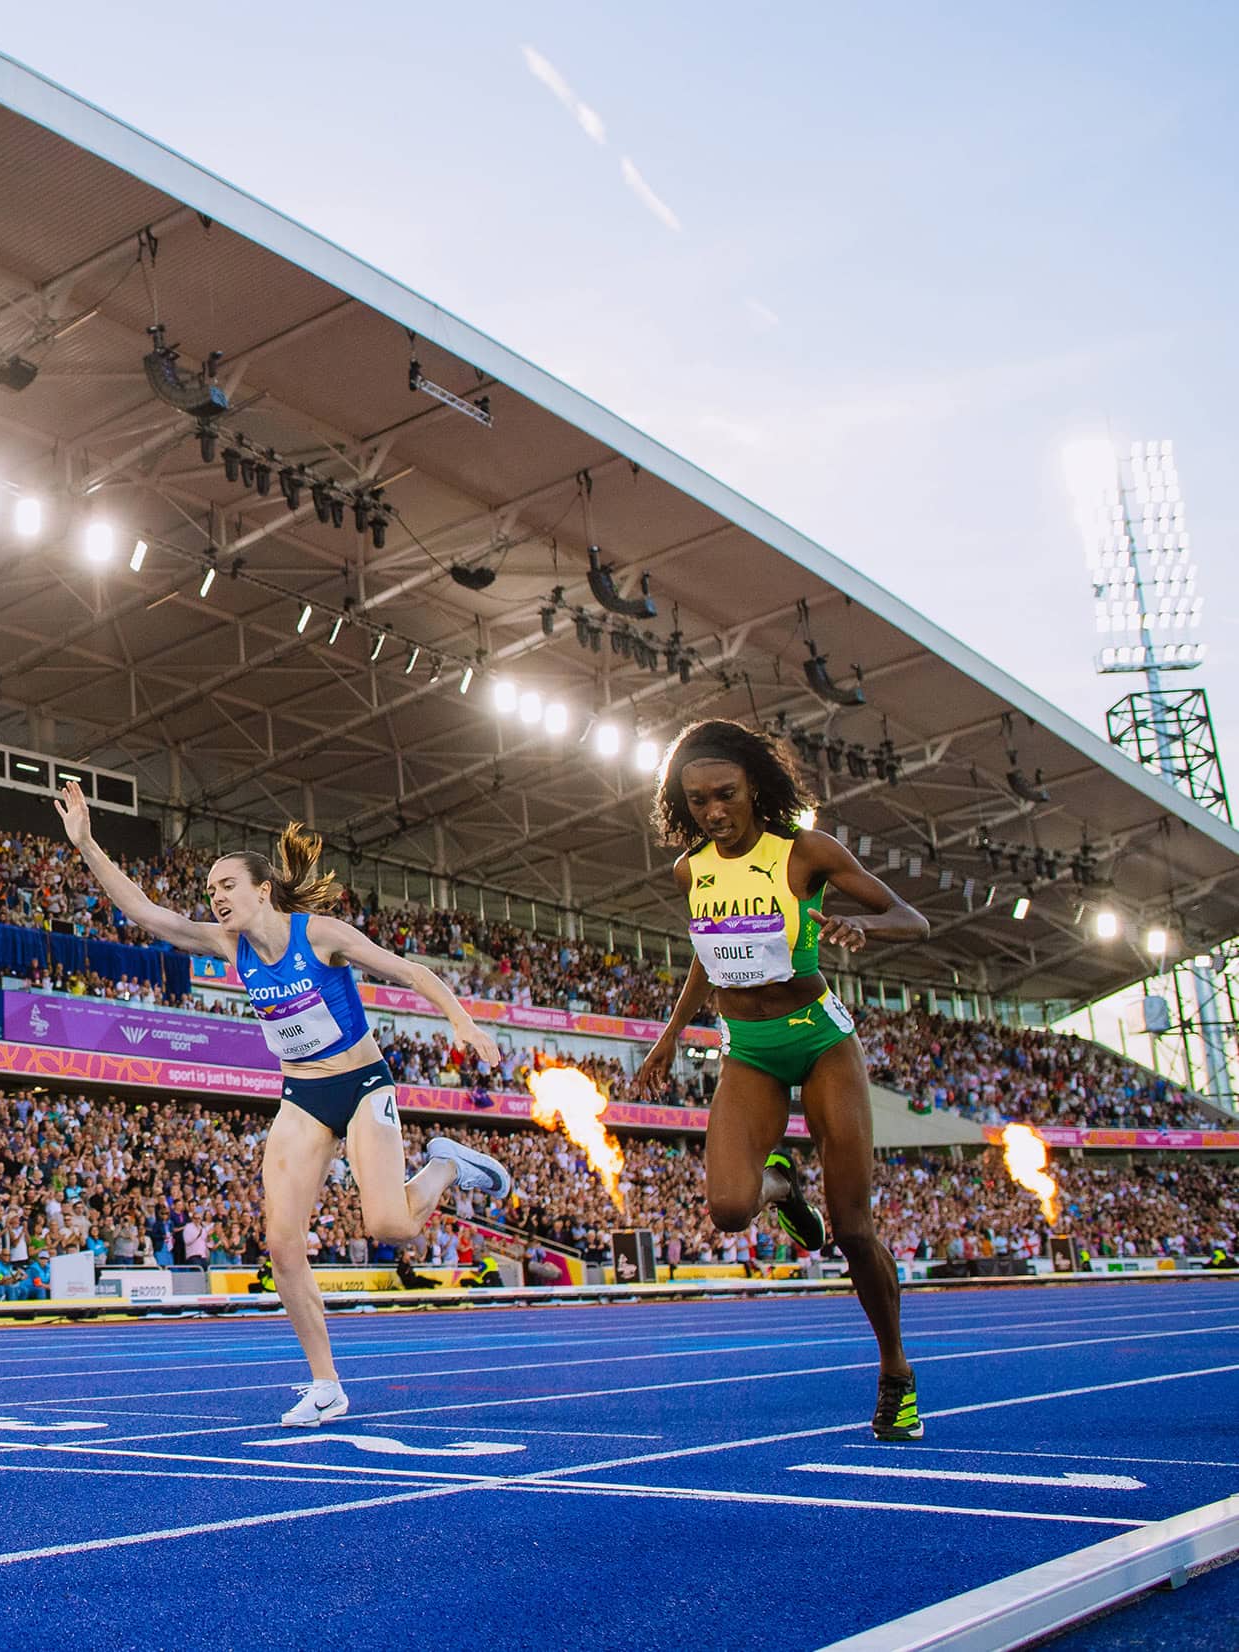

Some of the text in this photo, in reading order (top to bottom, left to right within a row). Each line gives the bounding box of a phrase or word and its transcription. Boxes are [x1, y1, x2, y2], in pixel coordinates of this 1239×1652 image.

[713, 945, 754, 960] GOULE
[249, 978, 313, 1001] SCOTLAND
[278, 1024, 305, 1040] MUIR
[169, 1069, 196, 1083] sport
[225, 1073, 241, 1086] the
[242, 1075, 282, 1091] beginnin
[384, 1096, 395, 1124] 4
